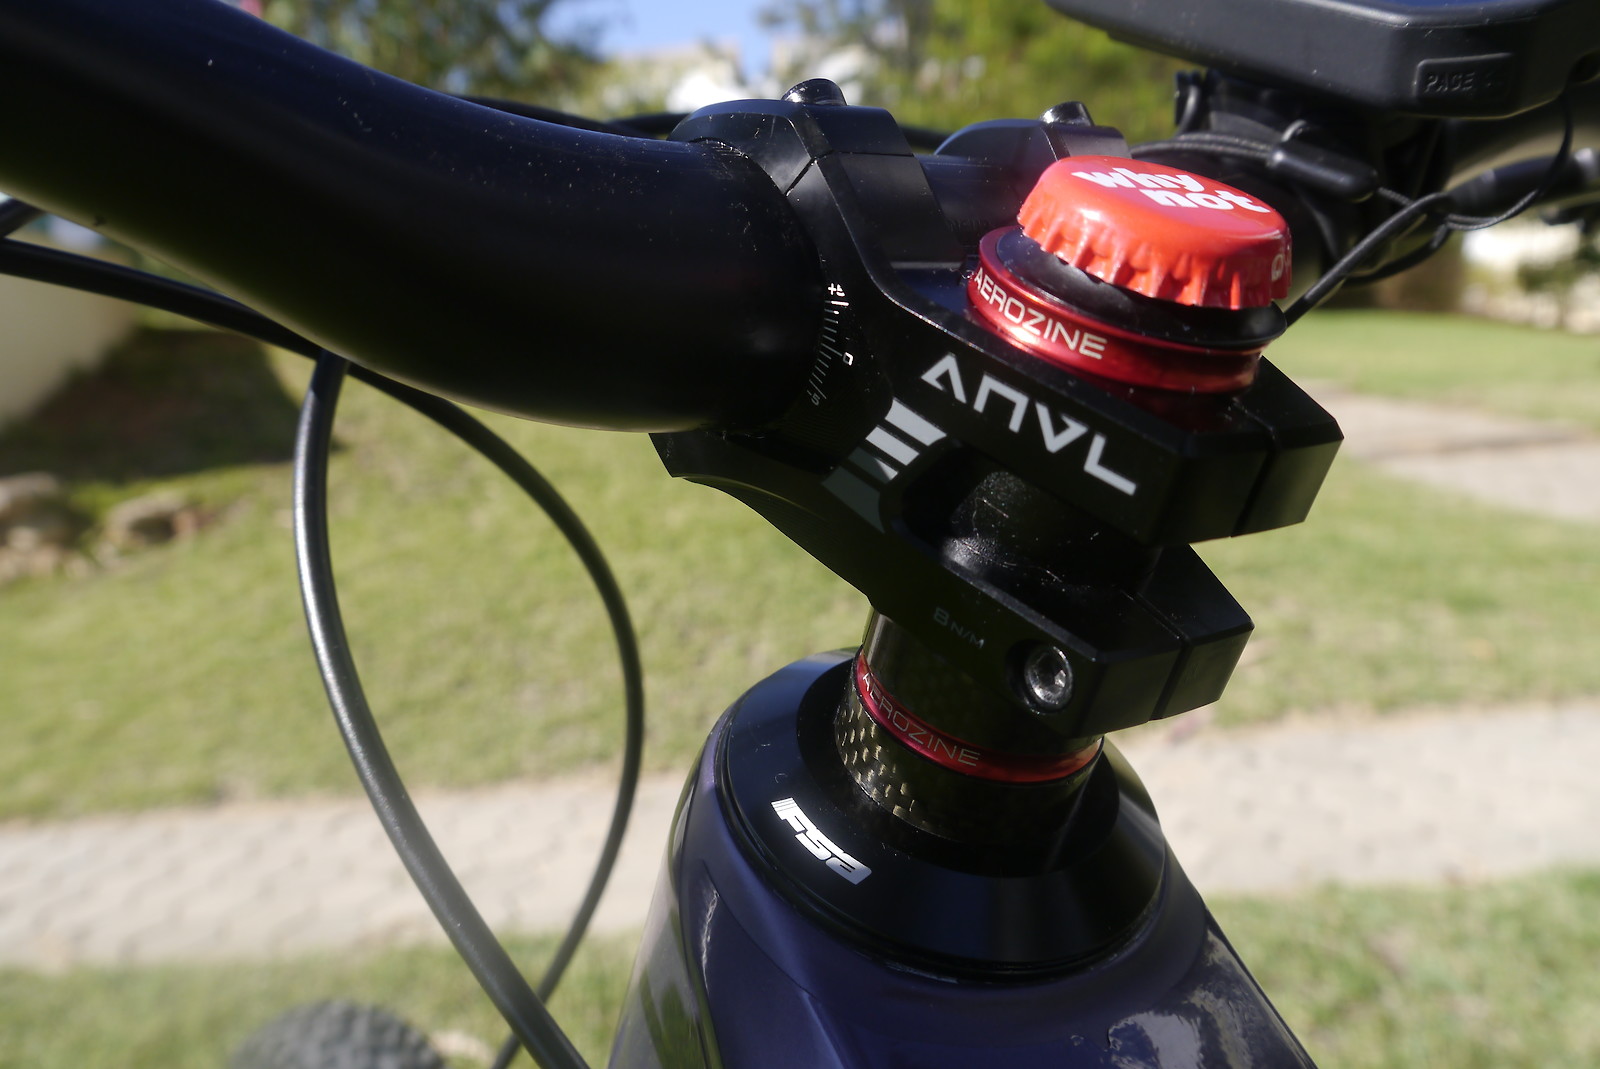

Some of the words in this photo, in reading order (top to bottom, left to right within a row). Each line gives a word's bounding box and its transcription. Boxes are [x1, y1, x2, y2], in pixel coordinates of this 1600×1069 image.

[1071, 167, 1205, 193] why
[1139, 188, 1271, 213] not
[973, 267, 1108, 360] AEROZINE
[921, 352, 1137, 496] ANVL
[862, 672, 981, 767] AEROZINE
